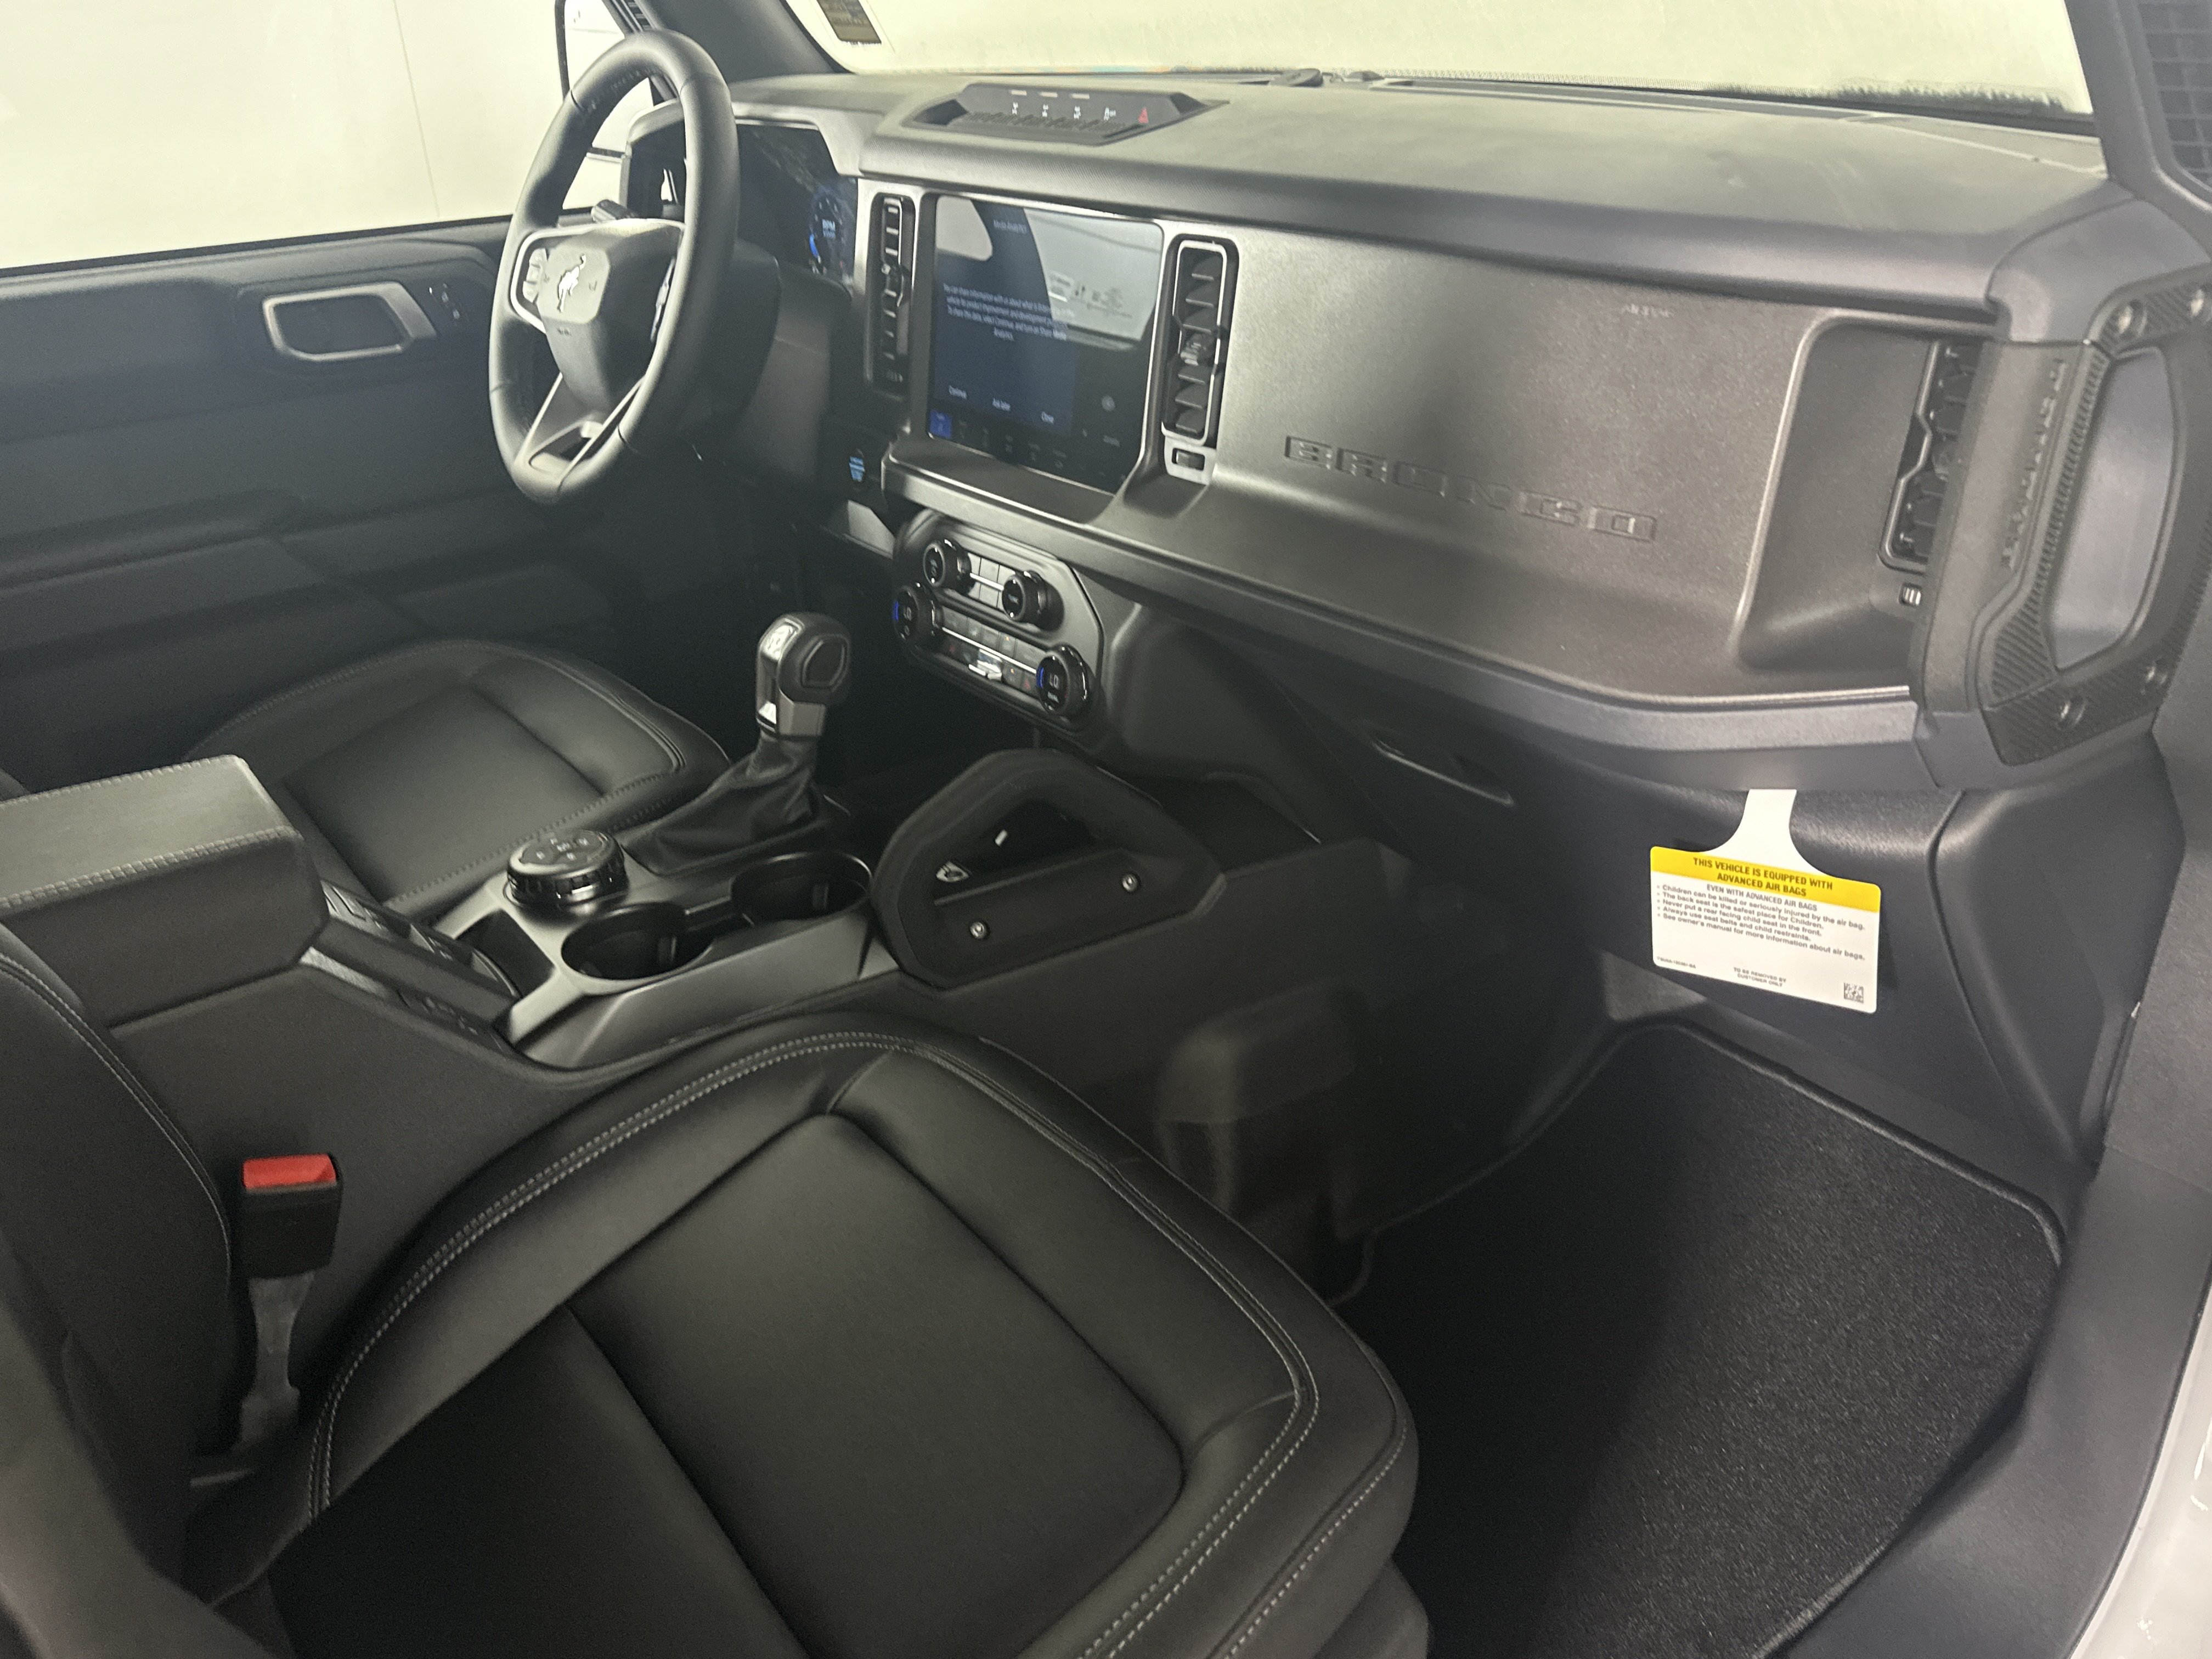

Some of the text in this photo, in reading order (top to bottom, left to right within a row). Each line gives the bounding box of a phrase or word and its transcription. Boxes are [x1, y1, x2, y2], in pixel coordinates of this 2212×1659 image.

[1284, 435, 1658, 543] BRONCO
[1694, 857, 1833, 890] THIS VEHICLE IS EQUIPPED WITH
[1717, 873, 1807, 896] ADVANCED AIR BAGS
[1663, 884, 1692, 895] Children
[1719, 895, 1737, 904] killed
[1750, 901, 1782, 914] seriously
[1784, 909, 1810, 919] injured
[1849, 921, 1865, 930] bag.
[1707, 884, 1818, 911] EVEN WITH ADVANCED AIR BAGS
[1663, 899, 1683, 907] Never
[1685, 903, 1696, 911] put
[1720, 910, 1741, 921] facing
[1743, 915, 1760, 923] child
[1763, 919, 1778, 927] seat
[1803, 927, 1822, 936] front.
[1663, 906, 1688, 917] Always
[1720, 918, 1737, 926] belts
[1755, 925, 1772, 933] child
[1774, 929, 1812, 941] restraints.
[1734, 906, 1755, 915] safest
[1757, 911, 1776, 921] place
[1791, 917, 1824, 929] Children.
[1678, 916, 1705, 927] owner's
[1707, 922, 1732, 932] manual
[1766, 934, 1808, 949] information
[1810, 944, 1831, 953] about
[1845, 951, 1865, 962] bags.
